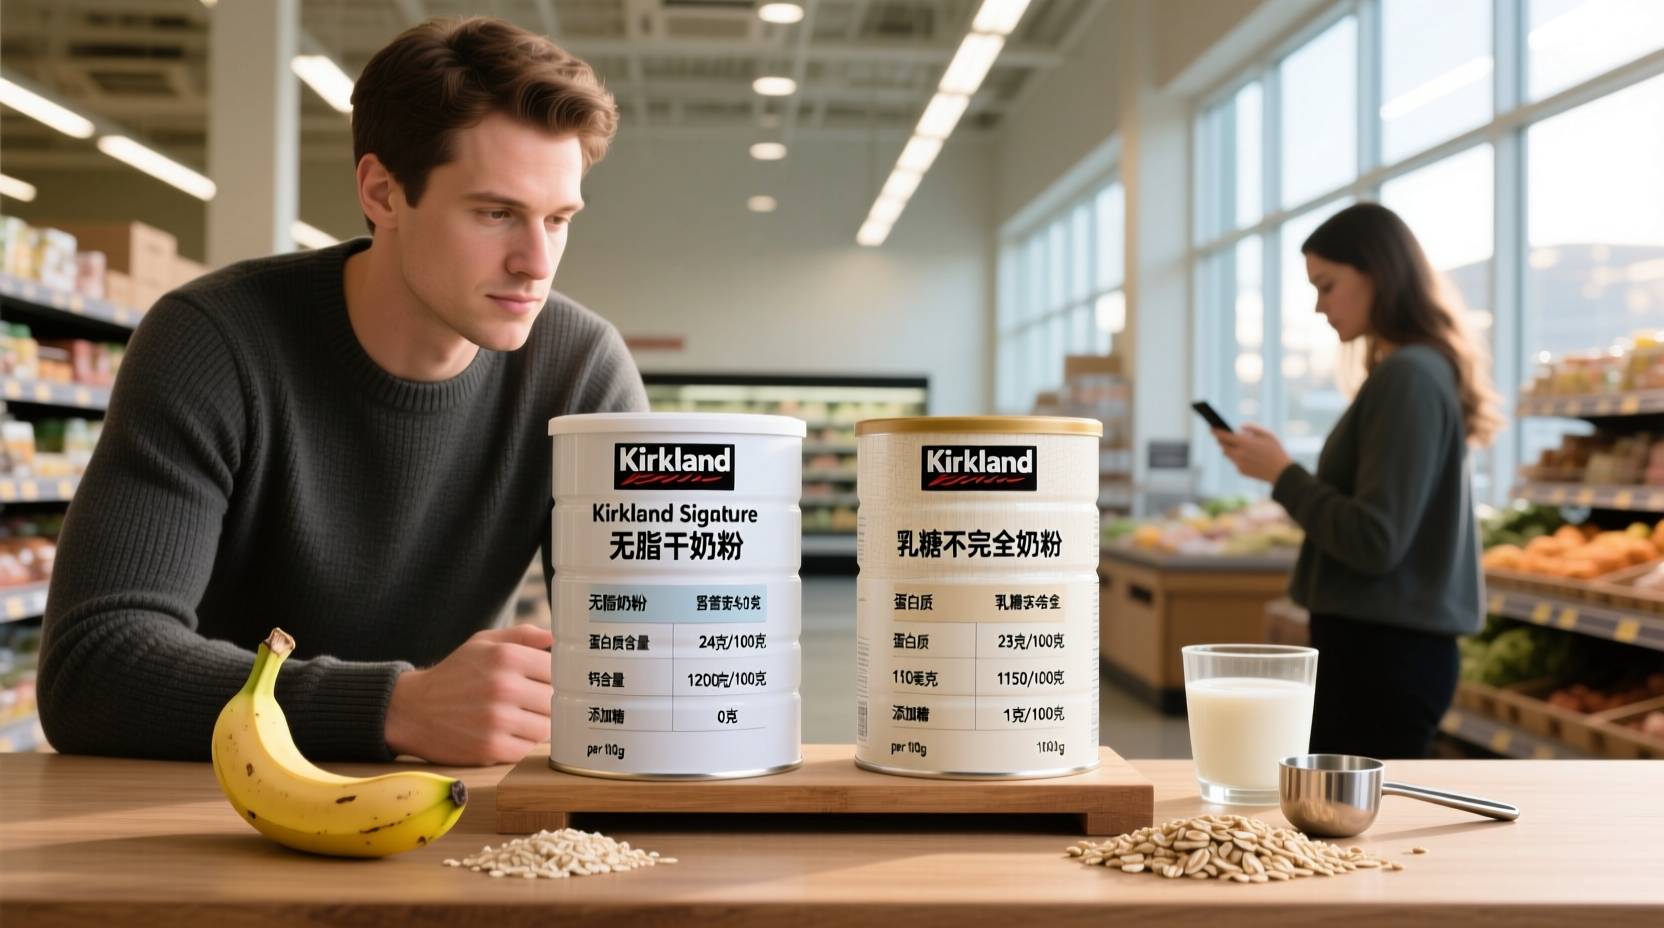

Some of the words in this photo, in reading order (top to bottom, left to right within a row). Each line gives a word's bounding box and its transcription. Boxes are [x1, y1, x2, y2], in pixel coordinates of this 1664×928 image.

[620, 447, 730, 472] Kirkland
[927, 449, 1033, 473] Kirkland
[593, 503, 673, 523] Kirkland
[610, 531, 743, 560] 无脂干奶粉
[897, 529, 1062, 558] 乳糖不完全奶粉
[894, 593, 933, 610] 蛋白质
[699, 633, 766, 651] 24克/100克
[998, 632, 1065, 650] 23克/100克
[997, 670, 1065, 688] 1150/100克
[718, 708, 738, 724] 0克
[1003, 706, 1065, 723] 1克/100克
